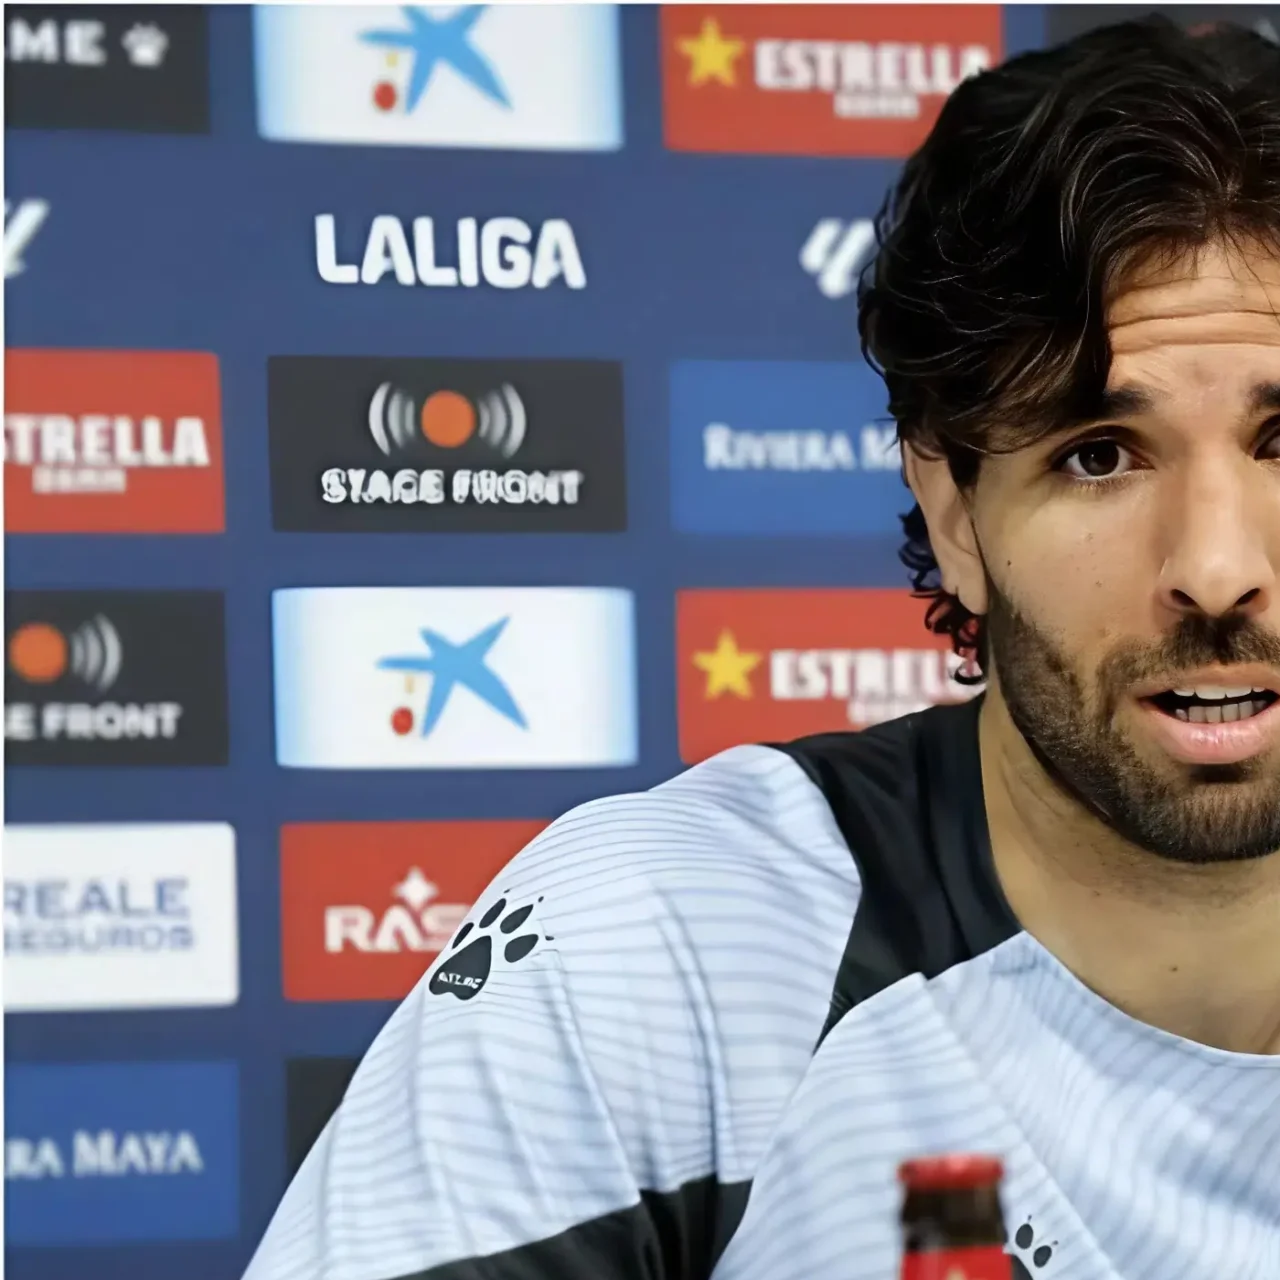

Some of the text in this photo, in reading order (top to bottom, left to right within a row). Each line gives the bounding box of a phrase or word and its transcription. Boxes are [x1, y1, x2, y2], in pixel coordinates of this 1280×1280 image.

[5, 17, 106, 65] ME
[314, 213, 586, 289] LALIGA
[5, 414, 210, 467] TRELLA
[42, 701, 183, 741] FRONT
[72, 1127, 205, 1178] MAYA
